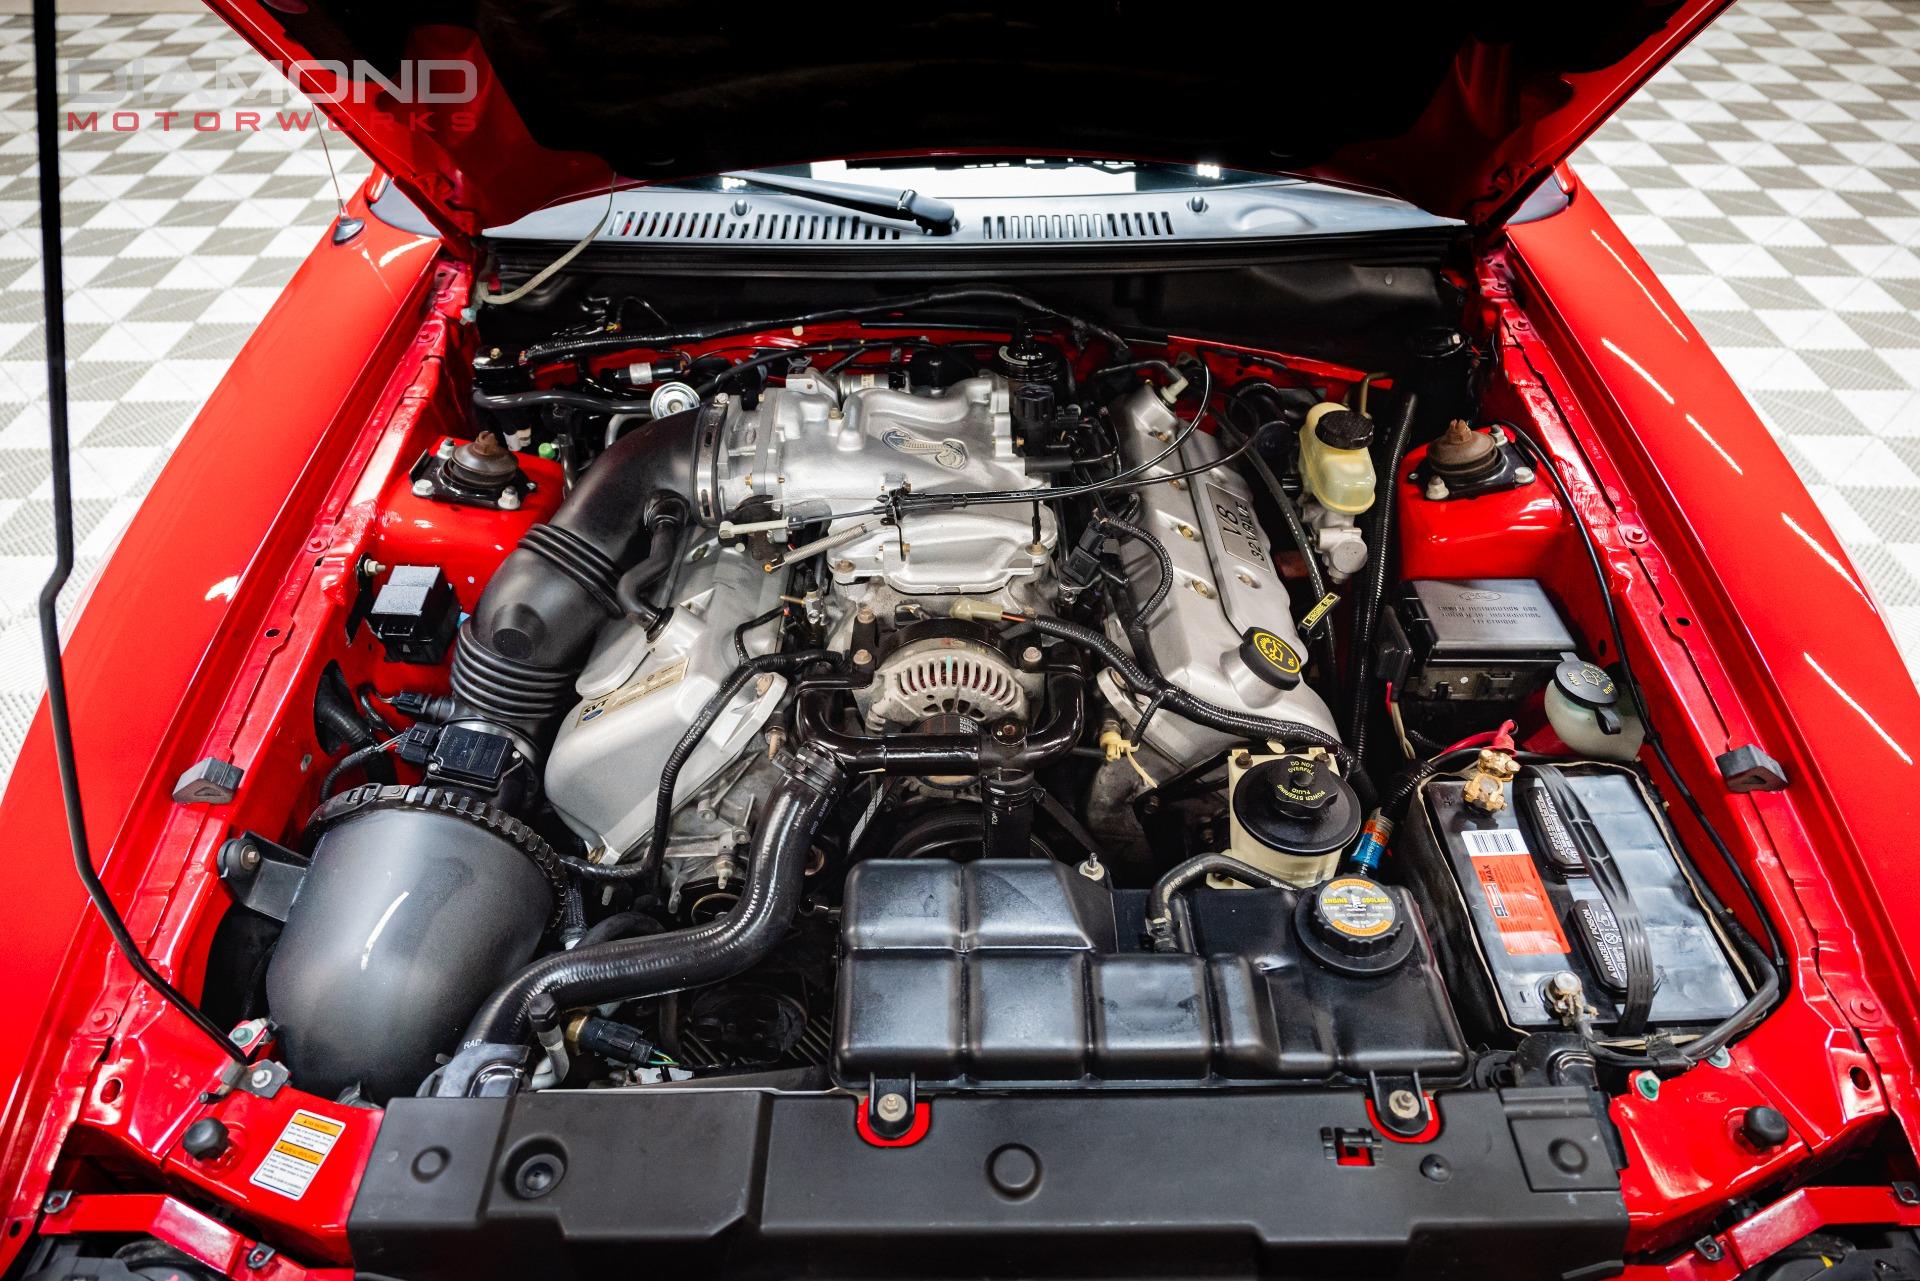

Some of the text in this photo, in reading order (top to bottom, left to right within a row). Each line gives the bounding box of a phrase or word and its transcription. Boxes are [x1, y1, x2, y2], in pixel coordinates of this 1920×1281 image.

[1216, 503, 1242, 537] V8
[582, 699, 609, 715] SVT
[1287, 766, 1315, 777] OVERFILL
[1301, 760, 1315, 768] NOT
[1483, 864, 1496, 882] MAX
[1582, 908, 1600, 935] POISON
[1597, 941, 1617, 972] DANGER
